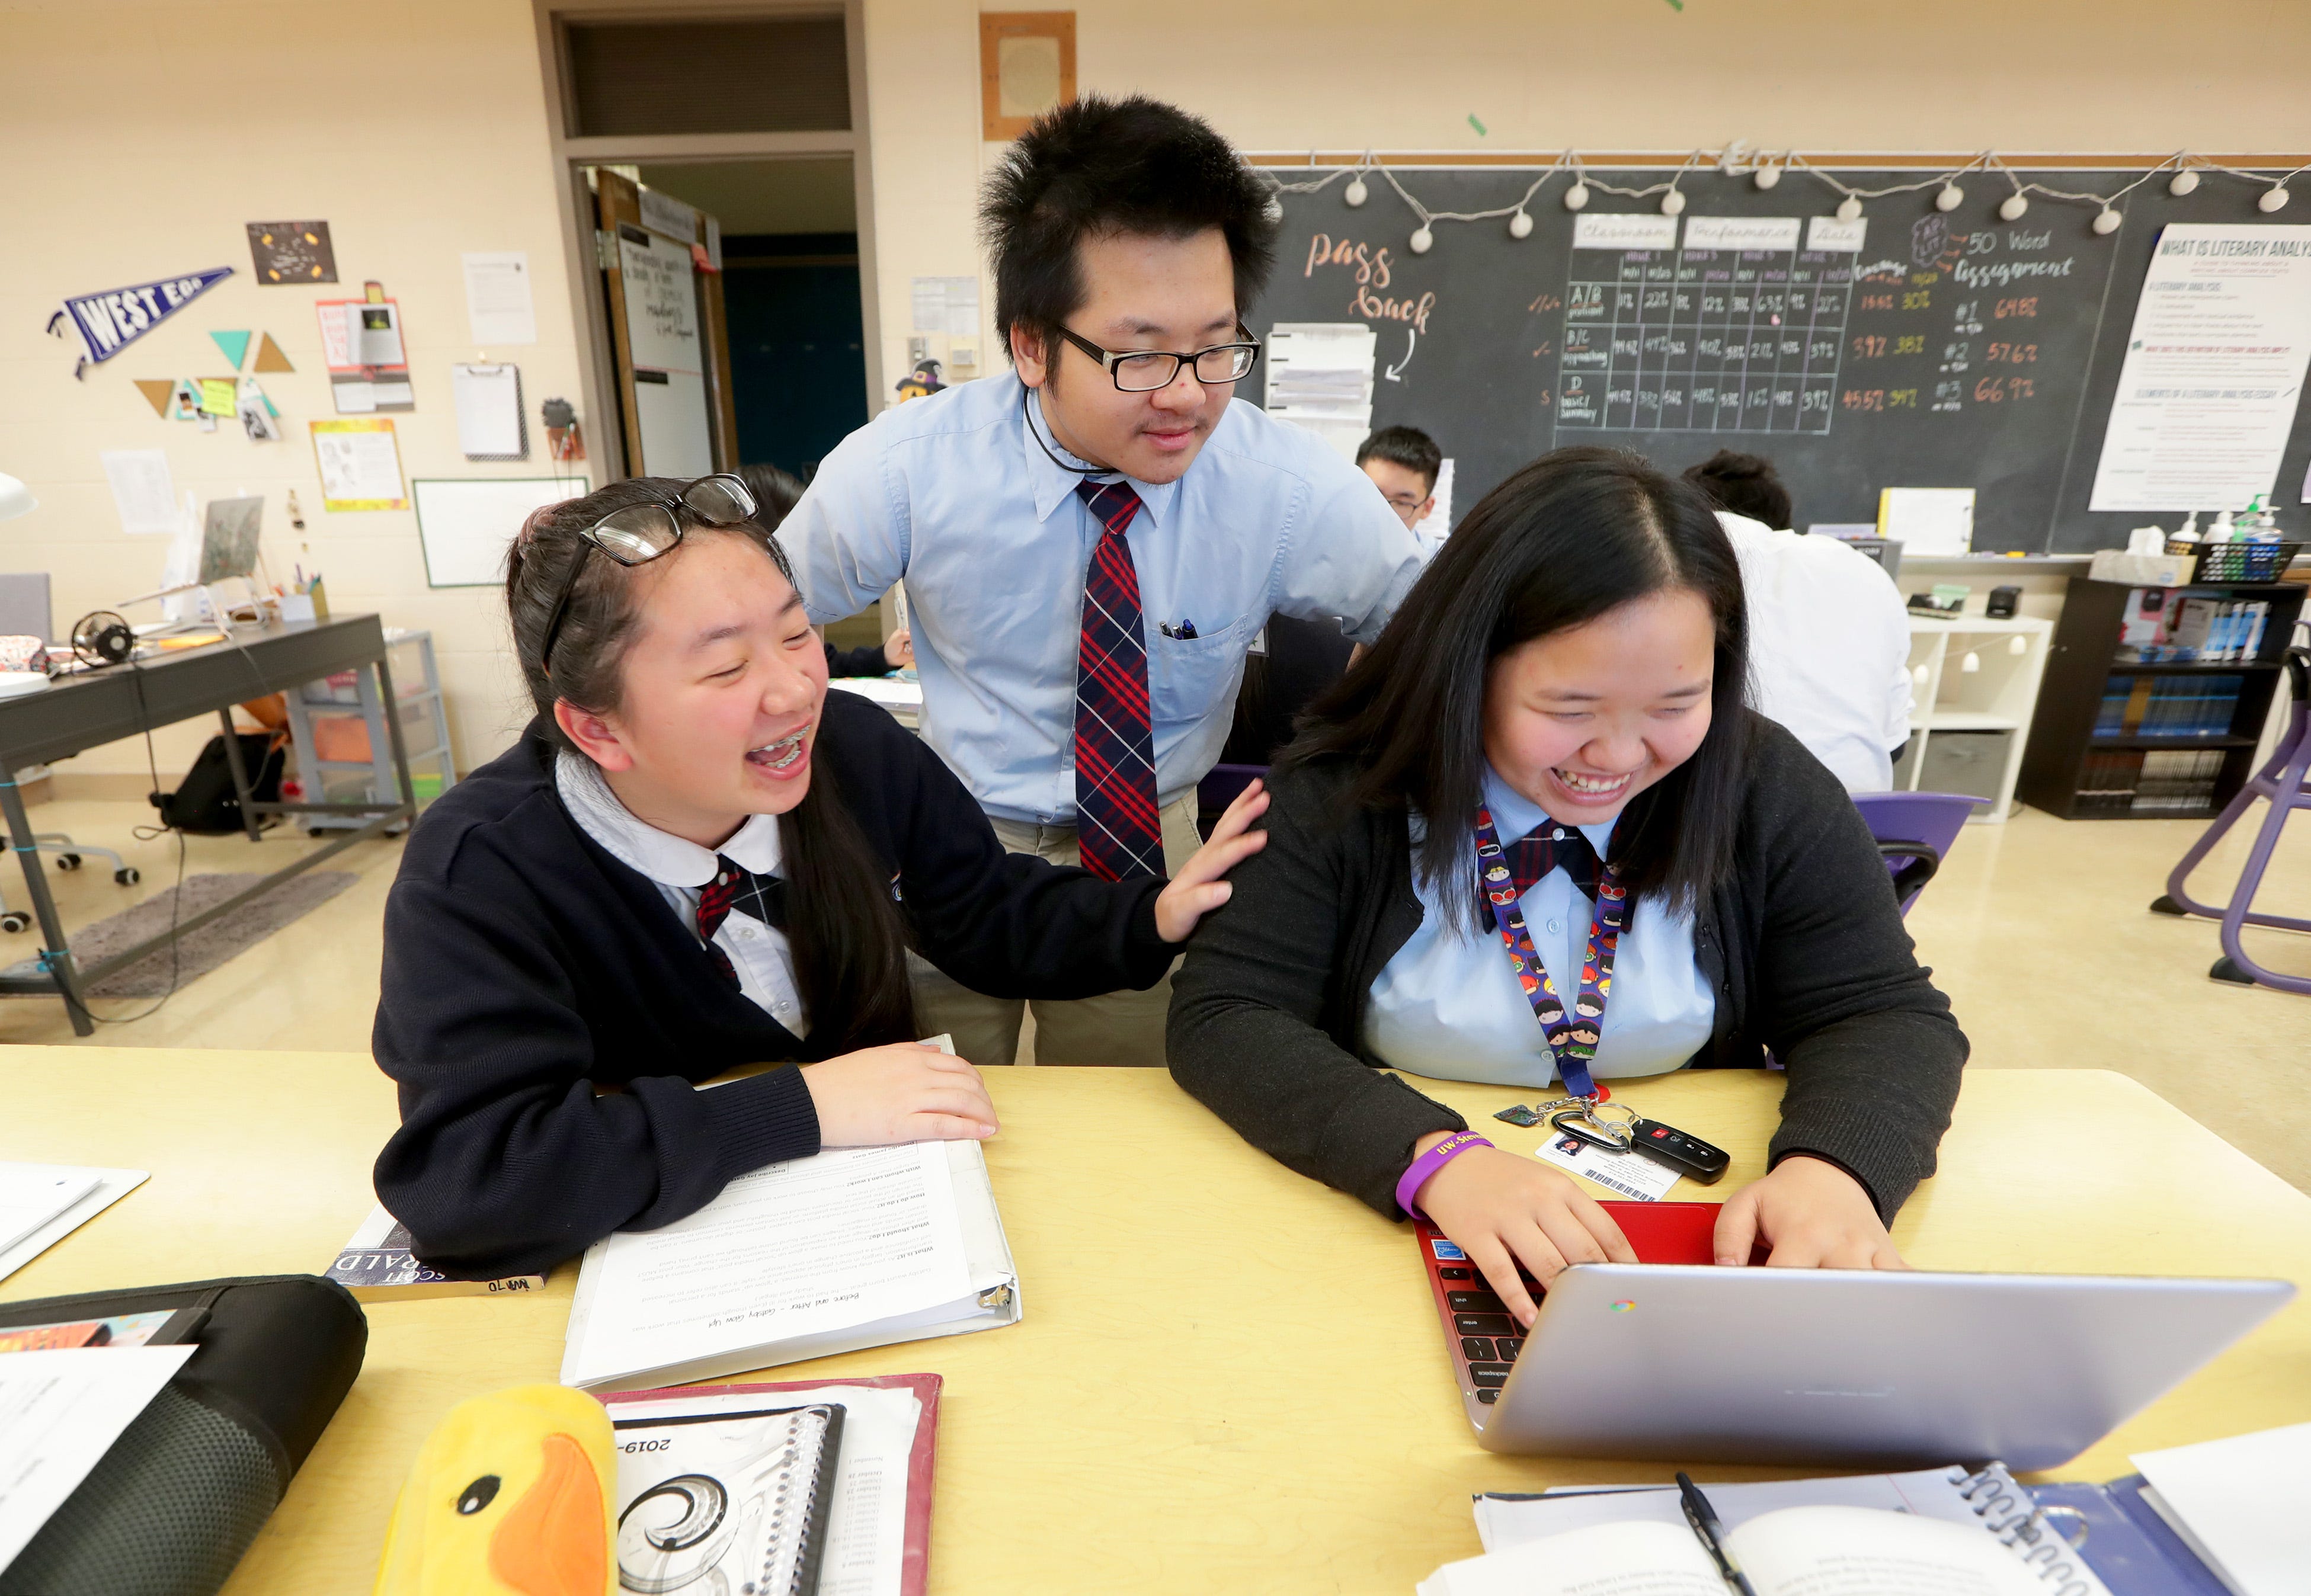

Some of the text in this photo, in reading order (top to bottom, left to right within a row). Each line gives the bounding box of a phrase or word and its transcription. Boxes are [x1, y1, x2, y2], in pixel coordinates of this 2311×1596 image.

[1967, 229, 2051, 255] 50 Word
[2160, 240, 2194, 257] WHAT
[2195, 240, 2209, 257] IS
[2210, 240, 2268, 257] LITERARY
[1570, 283, 1602, 306] A/B
[75, 287, 162, 354] WEST
[1566, 328, 1590, 347] B/C
[1570, 376, 1583, 391] D
[886, 1227, 909, 1236] should
[834, 1292, 859, 1301] Before
[748, 1308, 775, 1318] Gatsby
